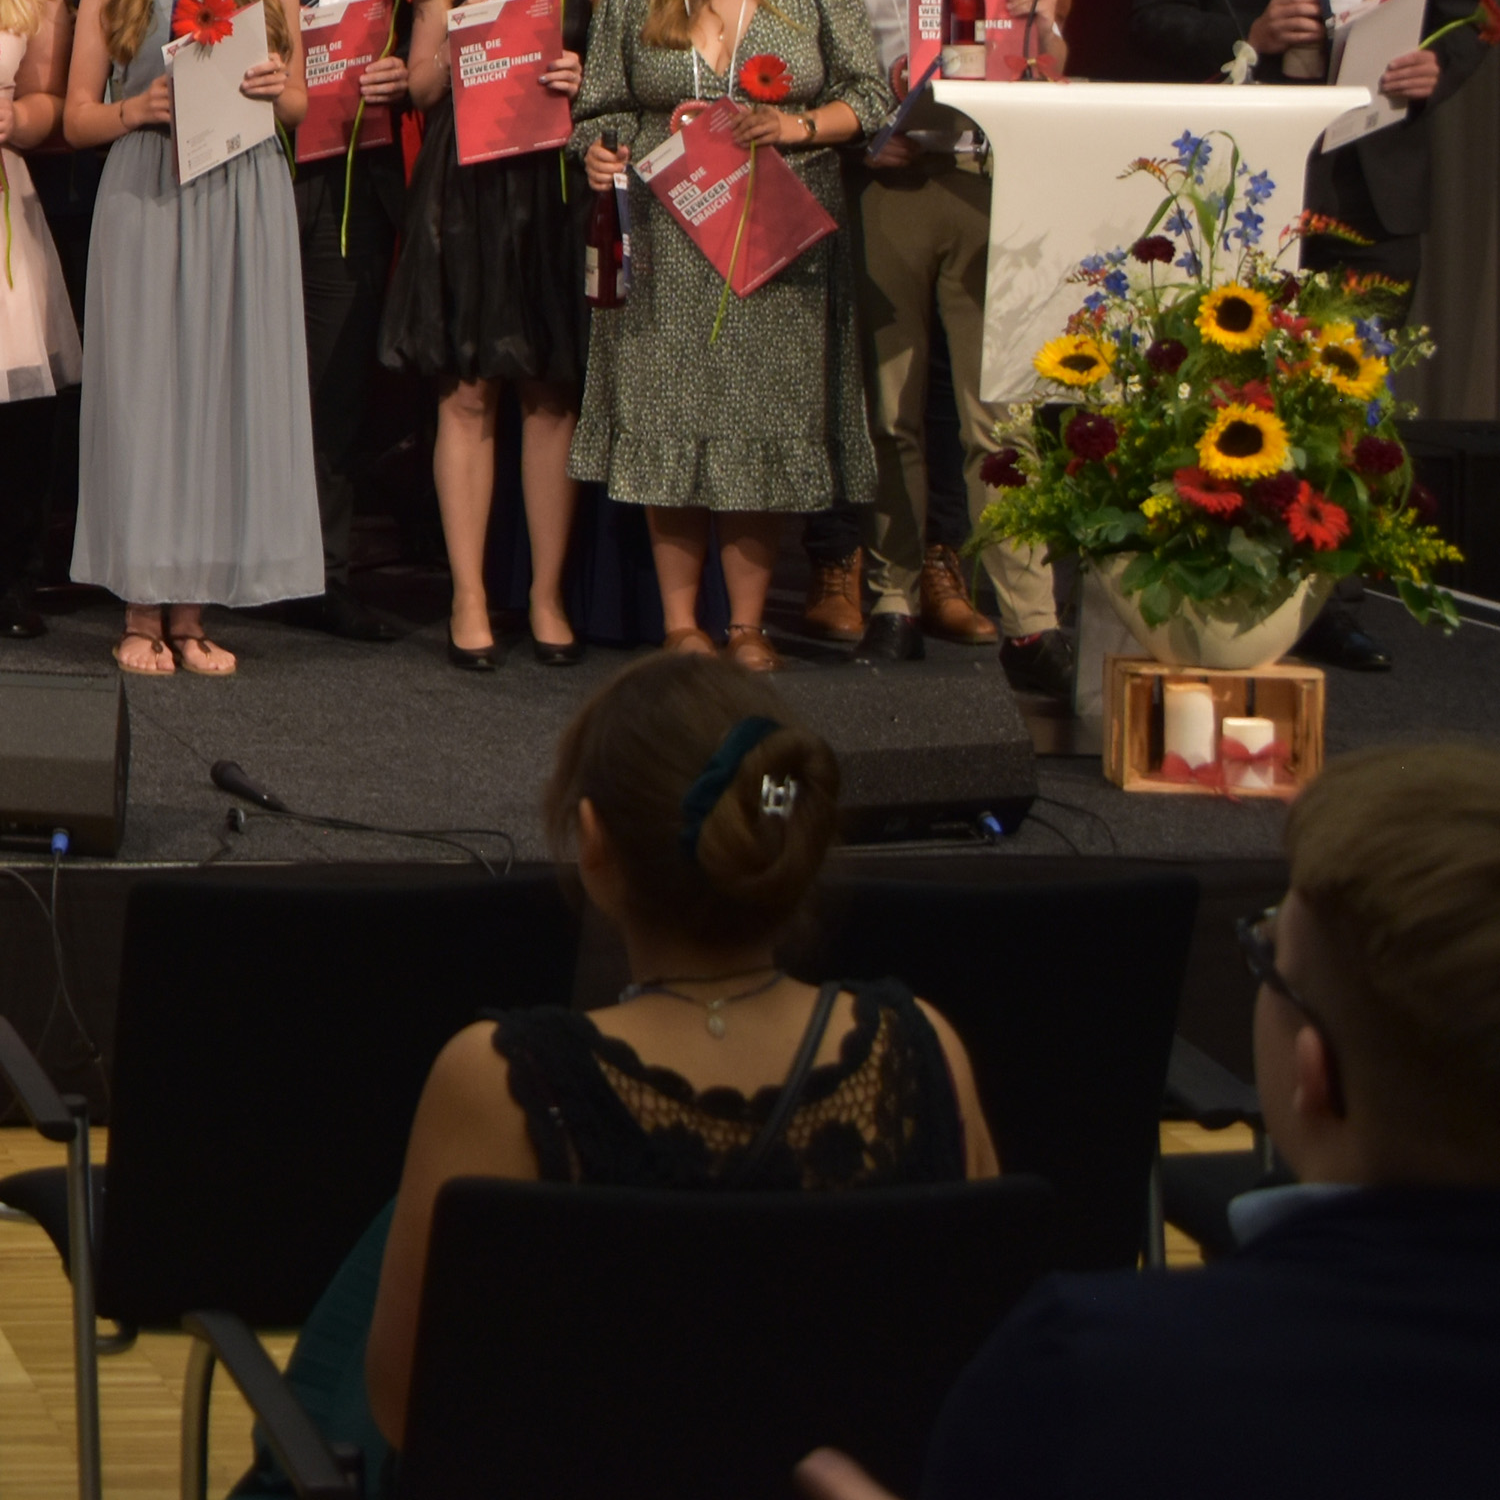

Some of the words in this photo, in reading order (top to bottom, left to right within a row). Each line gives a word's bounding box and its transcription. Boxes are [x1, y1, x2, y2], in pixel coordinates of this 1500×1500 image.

[308, 45, 328, 56] WEIL
[329, 40, 343, 51] DIE
[460, 42, 484, 55] WEIL
[485, 38, 502, 50] DIE
[308, 54, 328, 65] WELT
[461, 54, 485, 65] WELT
[462, 60, 509, 77] BEWEGER
[511, 51, 542, 67] INNEN
[307, 61, 346, 77] BEWEGER
[307, 71, 345, 88] BRAUCHT
[463, 71, 508, 88] BRAUCHT
[667, 178, 692, 199] WEIL
[689, 165, 707, 182] DIE
[675, 188, 699, 208] WELT
[683, 182, 728, 219] BEWEGER
[691, 192, 733, 227] BRAUCHT
